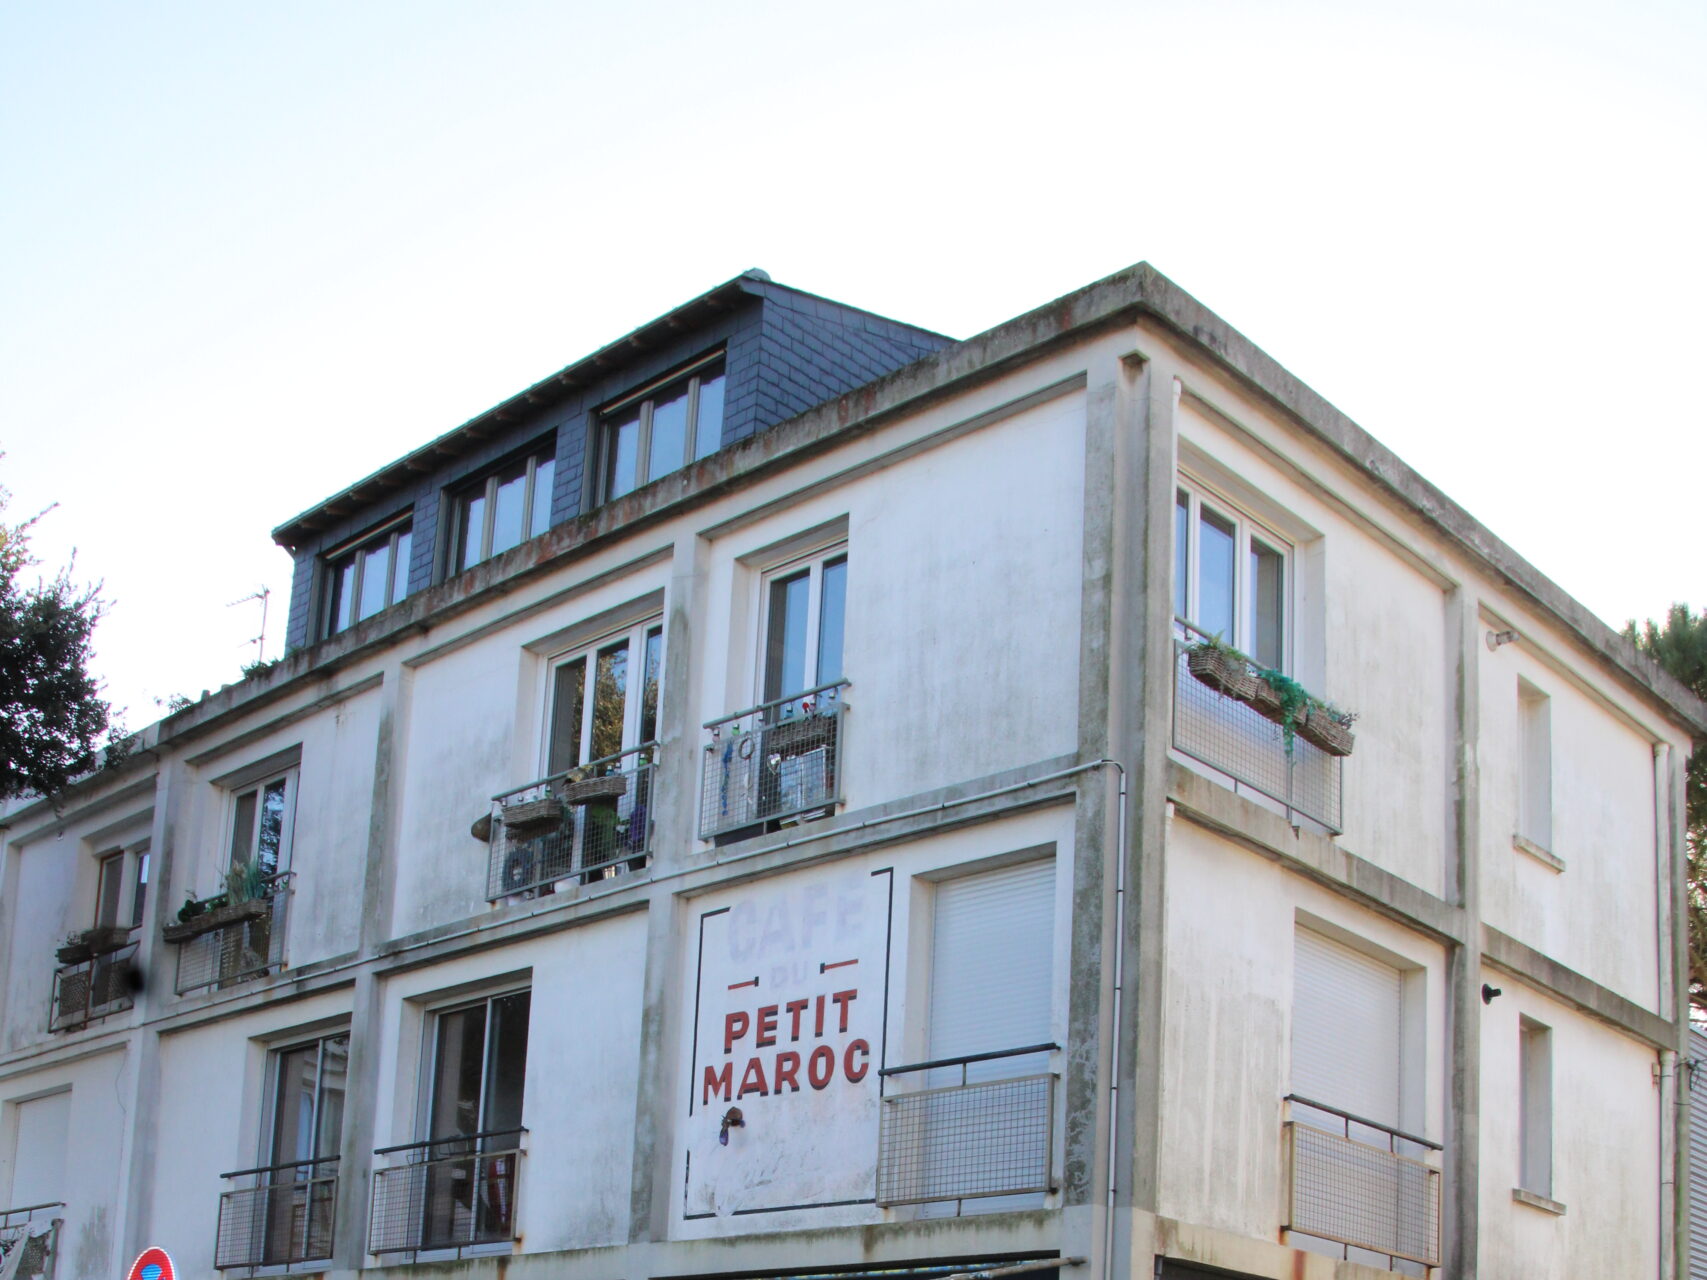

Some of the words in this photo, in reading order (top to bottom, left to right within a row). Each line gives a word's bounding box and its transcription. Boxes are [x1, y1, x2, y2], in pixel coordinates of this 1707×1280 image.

[769, 960, 809, 990] DU
[724, 989, 858, 1054] PETIT
[703, 1038, 870, 1106] MAROC
